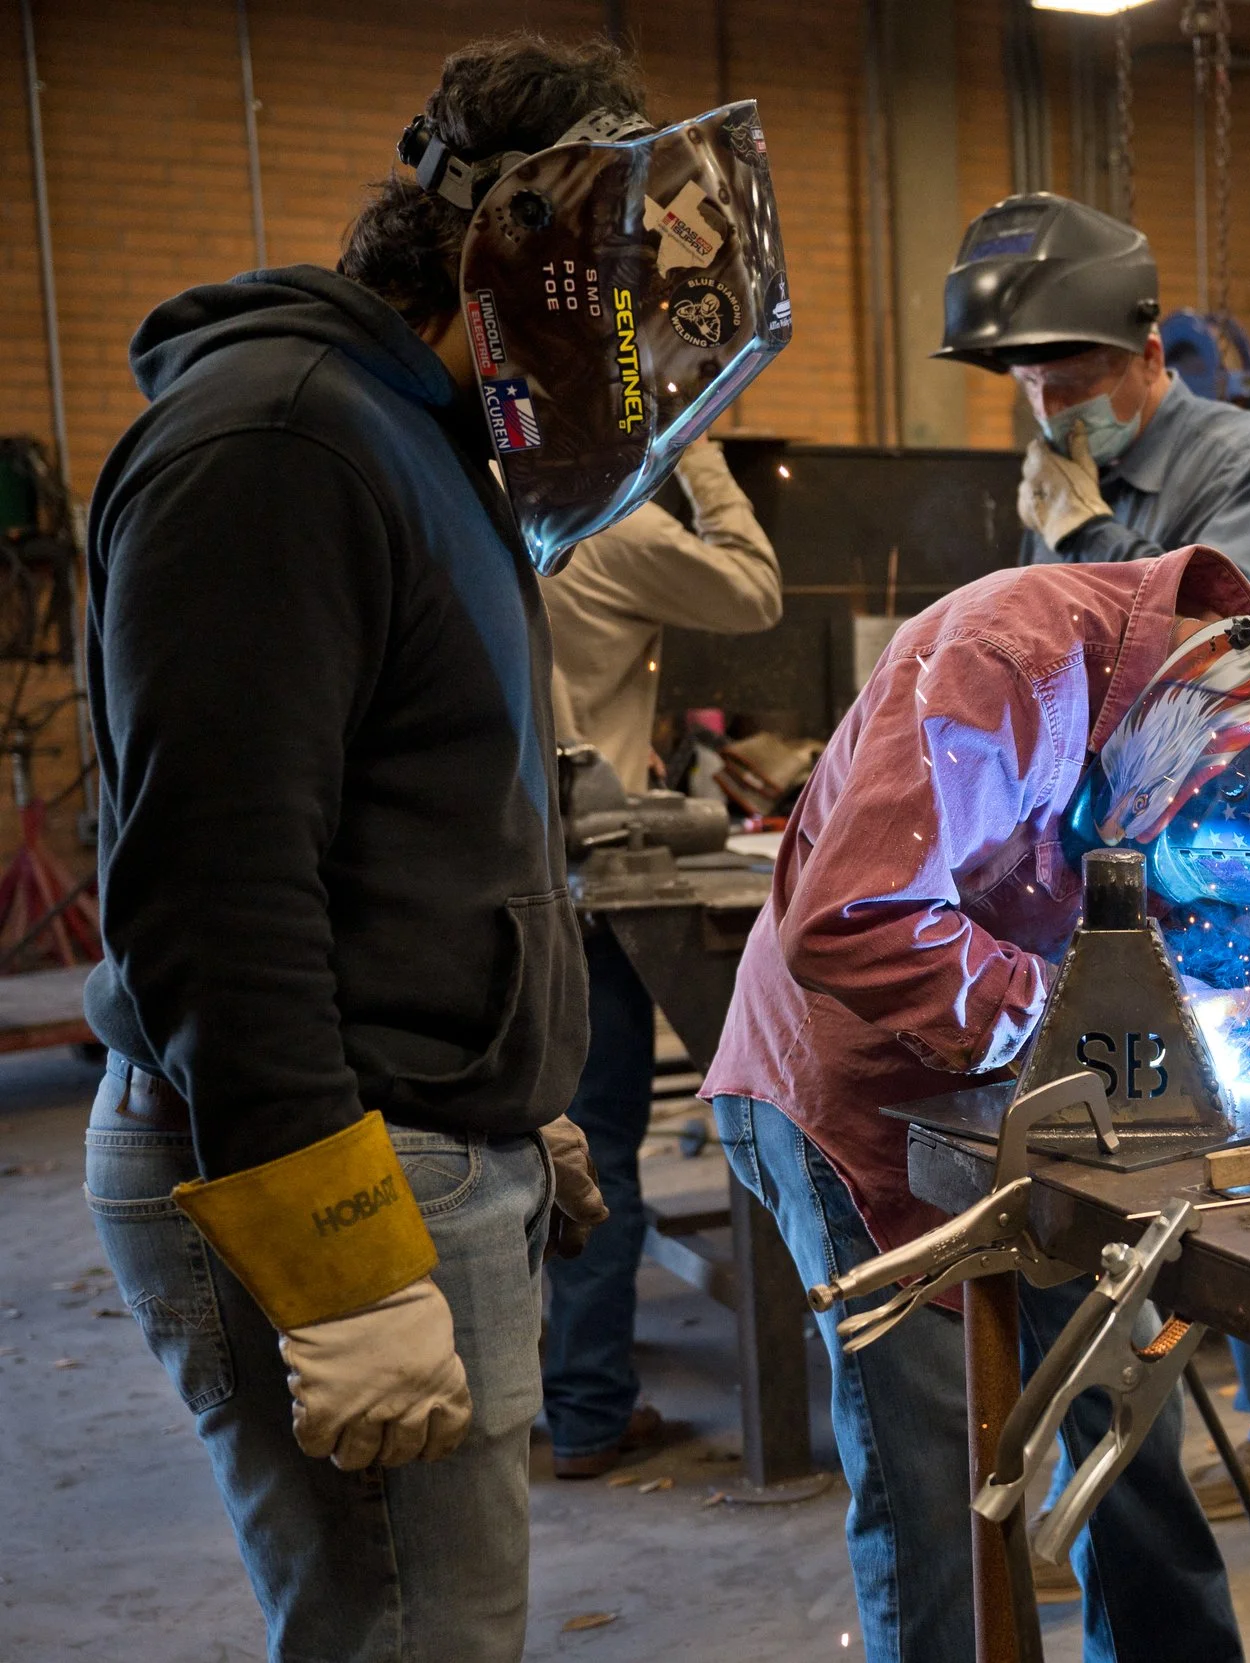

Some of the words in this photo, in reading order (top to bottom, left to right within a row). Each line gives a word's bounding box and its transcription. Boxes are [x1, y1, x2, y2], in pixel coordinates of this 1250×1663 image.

[672, 226, 709, 256] SUPPLY
[677, 220, 698, 240] GAS
[542, 261, 560, 311] TOE
[563, 260, 578, 310] POO
[586, 269, 601, 317] SMD
[688, 278, 715, 288] BLUE
[716, 283, 741, 326] DIAMOND
[471, 310, 492, 369] ELECTRIC
[479, 293, 504, 362] LINCOLN
[671, 316, 707, 347] WELDING
[613, 287, 643, 434] SENTINEL
[483, 385, 511, 449] ACUREN
[1076, 1031, 1169, 1099] SB
